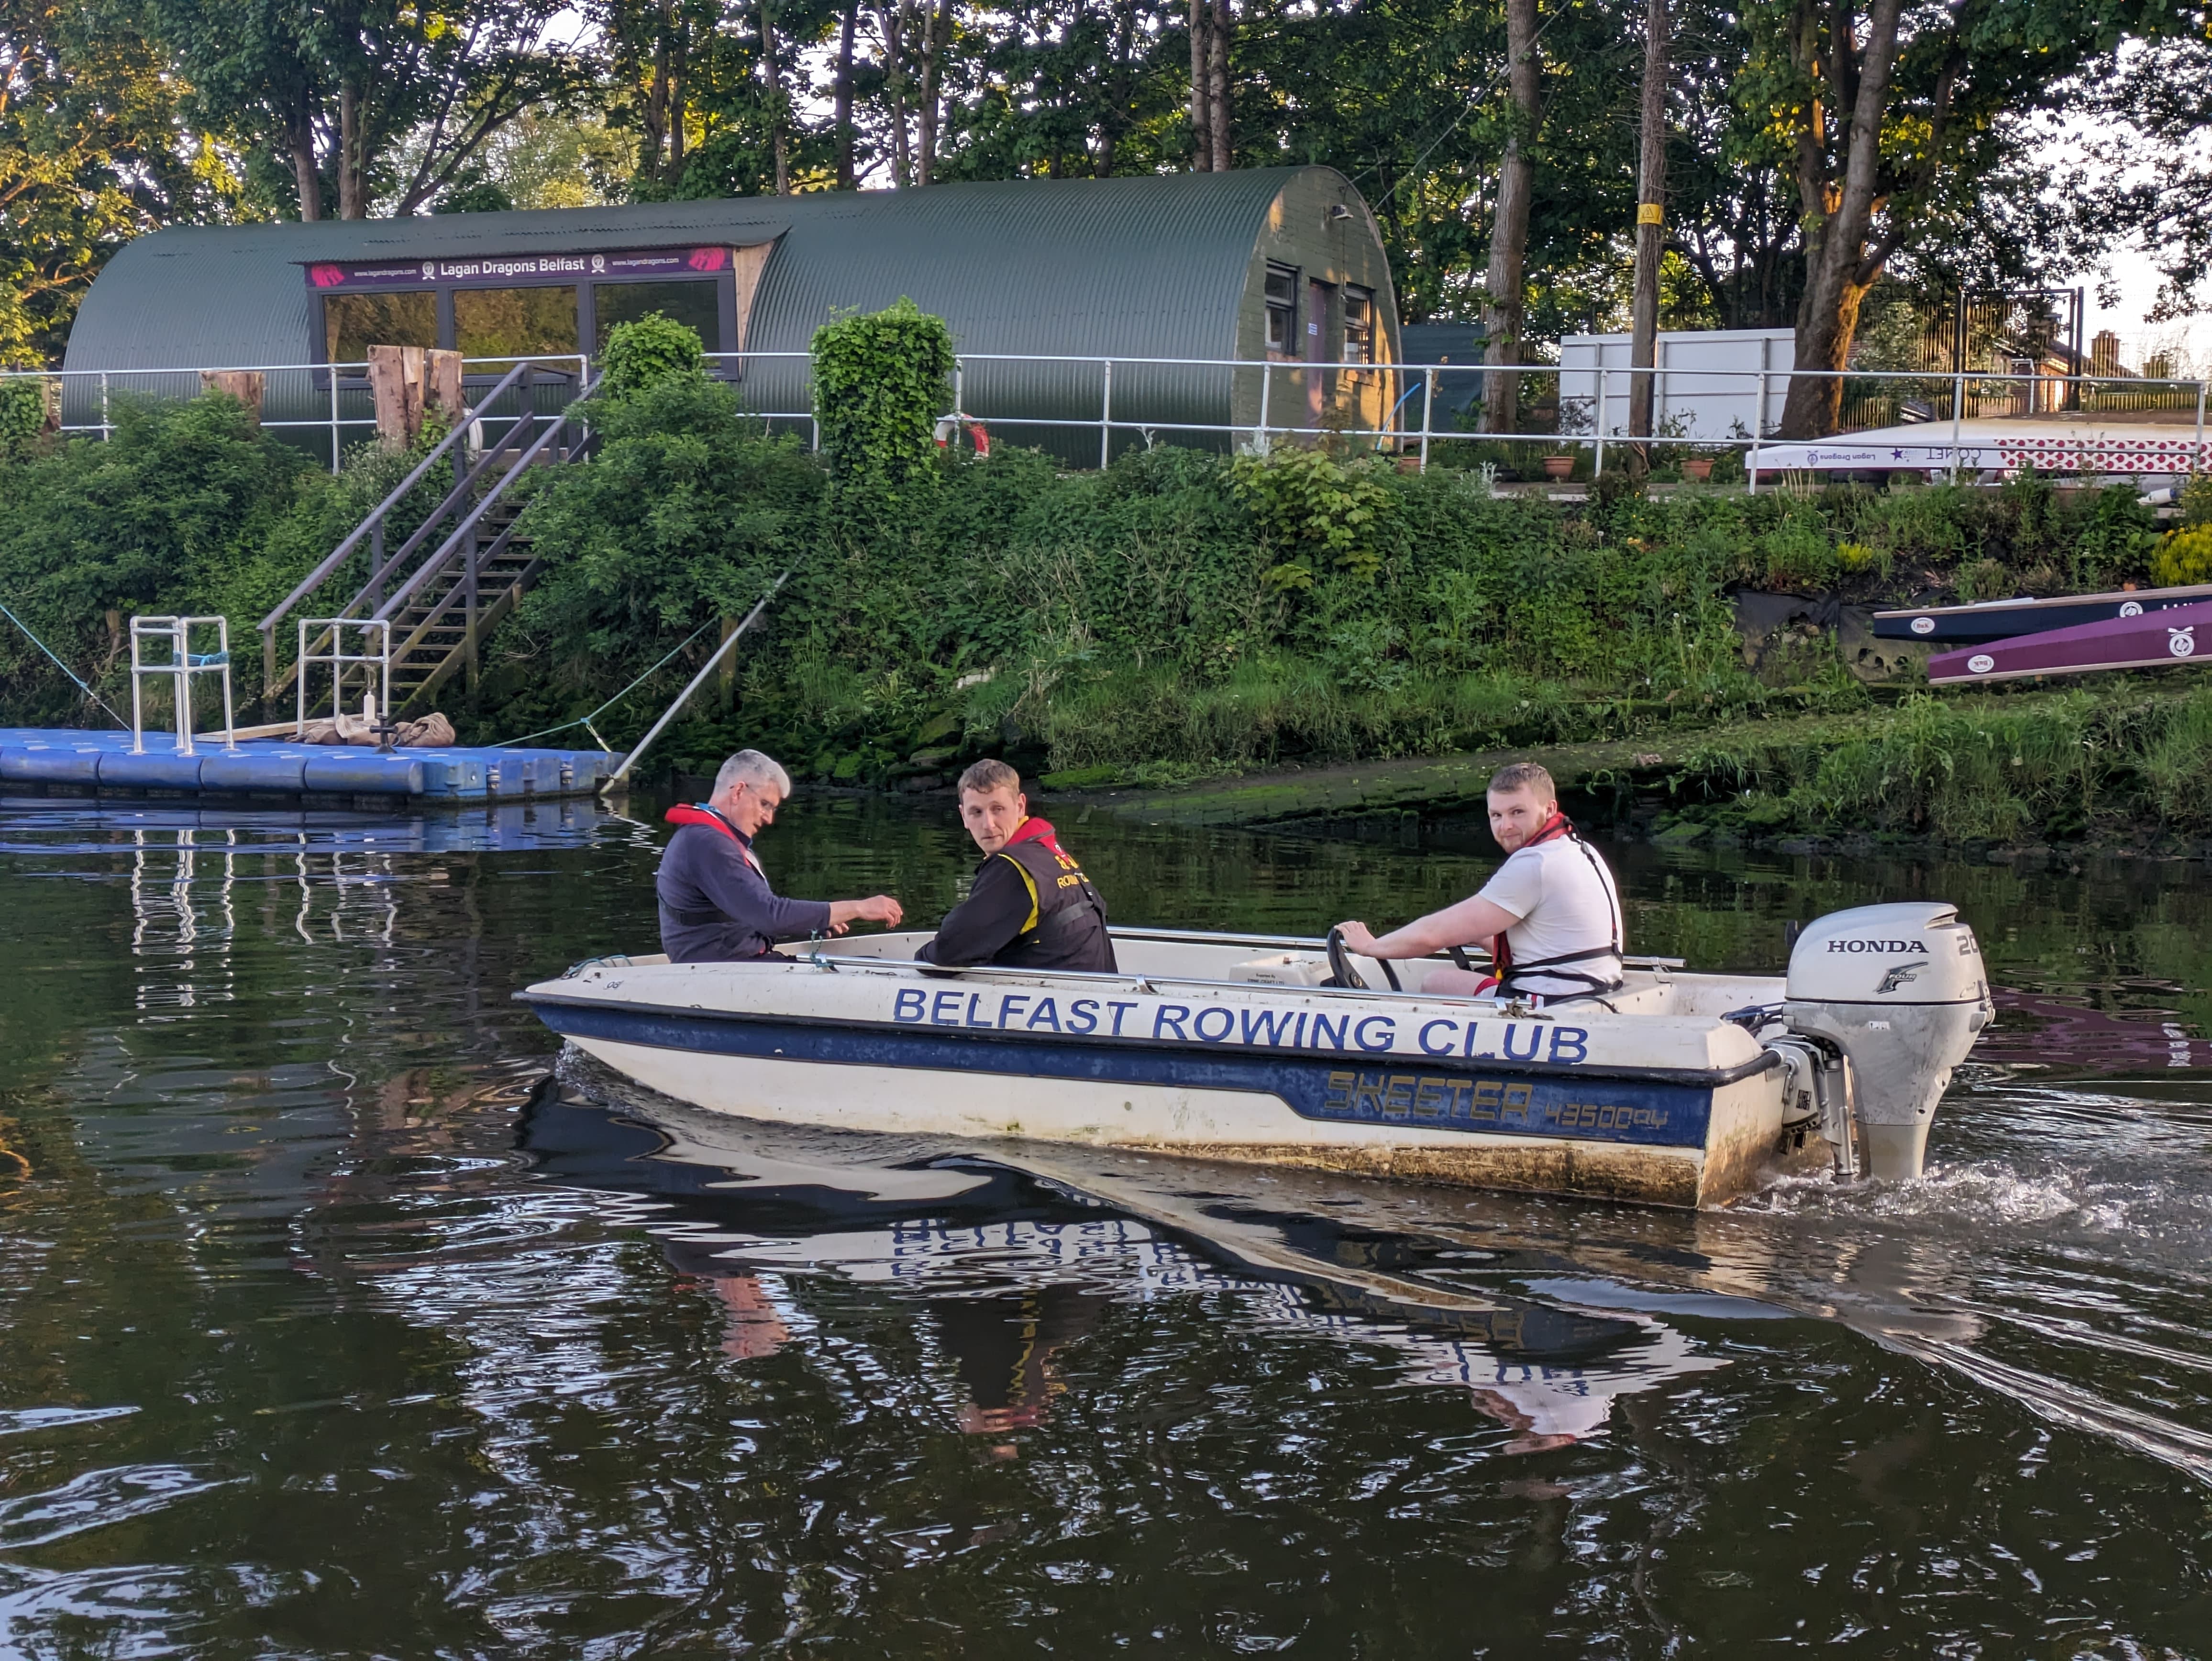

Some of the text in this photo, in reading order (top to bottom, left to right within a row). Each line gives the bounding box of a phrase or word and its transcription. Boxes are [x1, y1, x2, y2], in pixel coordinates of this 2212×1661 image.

[441, 258, 585, 278] Lagan Dragons Belfast
[1827, 940, 1929, 953] HONDA
[894, 988, 1588, 1065] BELFAST ROWING CLUB
[1325, 1071, 1533, 1122] SKEETER
